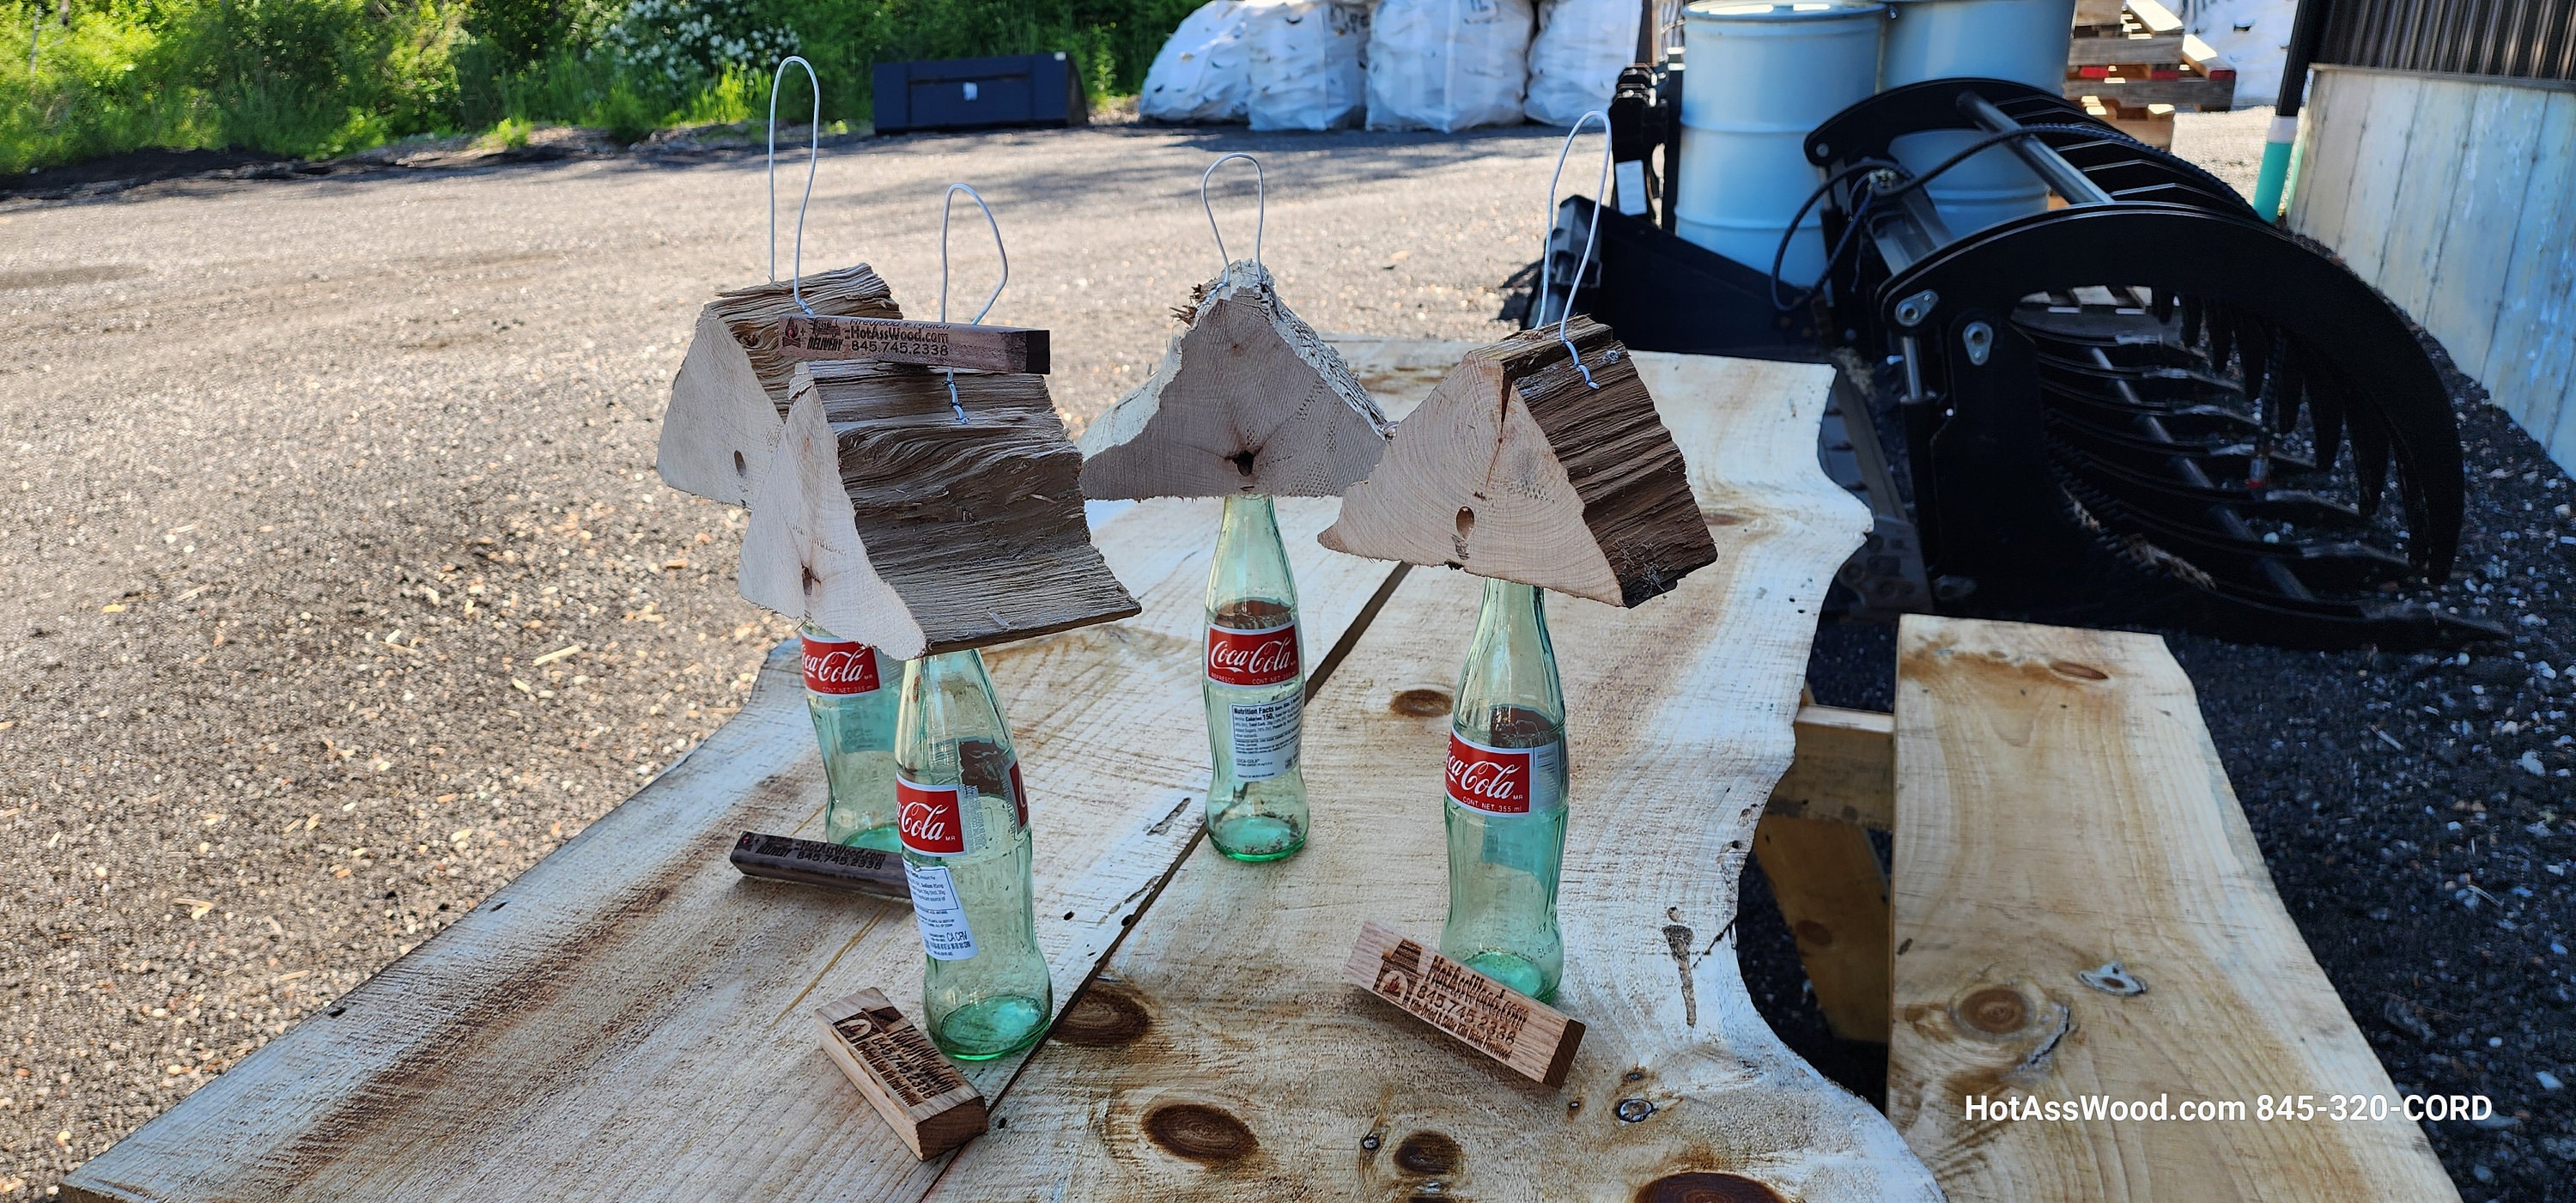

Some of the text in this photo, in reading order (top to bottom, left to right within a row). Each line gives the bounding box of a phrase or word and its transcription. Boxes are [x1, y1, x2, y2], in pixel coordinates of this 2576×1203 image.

[850, 325, 949, 344] HotAssWood.com
[851, 341, 949, 356] 845.745.2338
[1462, 796, 1479, 807] CONT.
[1481, 802, 1496, 811] NET.
[796, 851, 883, 871] 845.745.2338
[946, 932, 957, 942] CA
[955, 930, 968, 942] CRV
[1425, 955, 1529, 1030] HotAssWood.com
[1417, 985, 1516, 1046] 845.745.2338
[1443, 1015, 1457, 1030] Solar
[1454, 1023, 1469, 1040] Kiln
[1467, 1029, 1485, 1047] Dried
[871, 1037, 936, 1099] 845.745.2338
